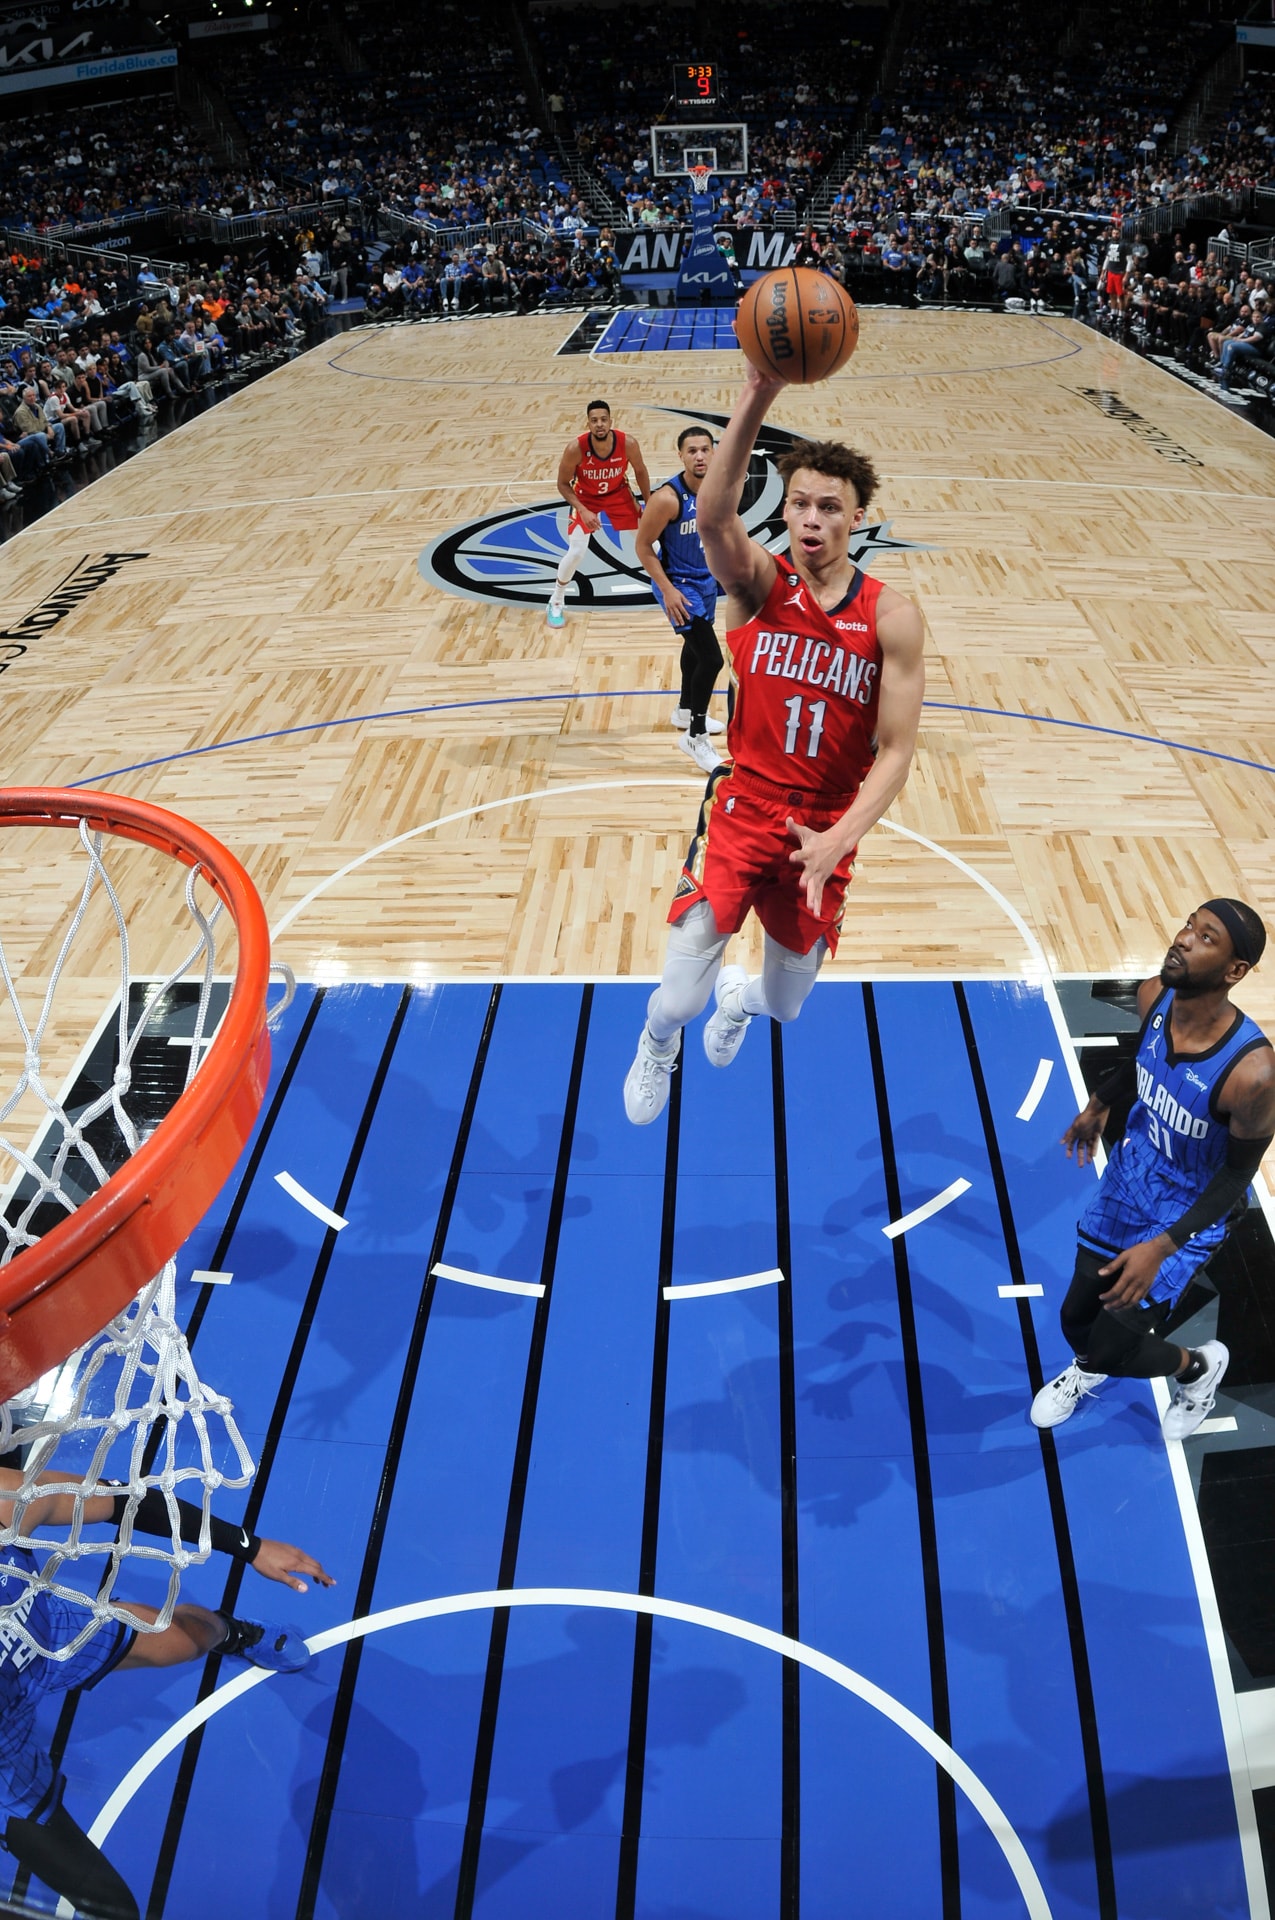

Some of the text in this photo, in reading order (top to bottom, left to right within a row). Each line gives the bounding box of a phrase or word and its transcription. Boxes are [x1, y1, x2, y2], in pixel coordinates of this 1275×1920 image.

[687, 66, 713, 78] 3:33
[697, 77, 710, 96] 9
[689, 97, 717, 105] TISSOT
[91, 235, 132, 250] verizon
[681, 271, 728, 283] KIA
[527, 303, 650, 315] MAGIC
[766, 281, 794, 360] Wilson
[597, 481, 609, 495] 3
[835, 619, 868, 632] ibotta
[750, 631, 878, 705] PELICANS
[784, 694, 828, 759] 11
[1153, 1014, 1163, 1030] 6
[1147, 1108, 1173, 1161] 31
